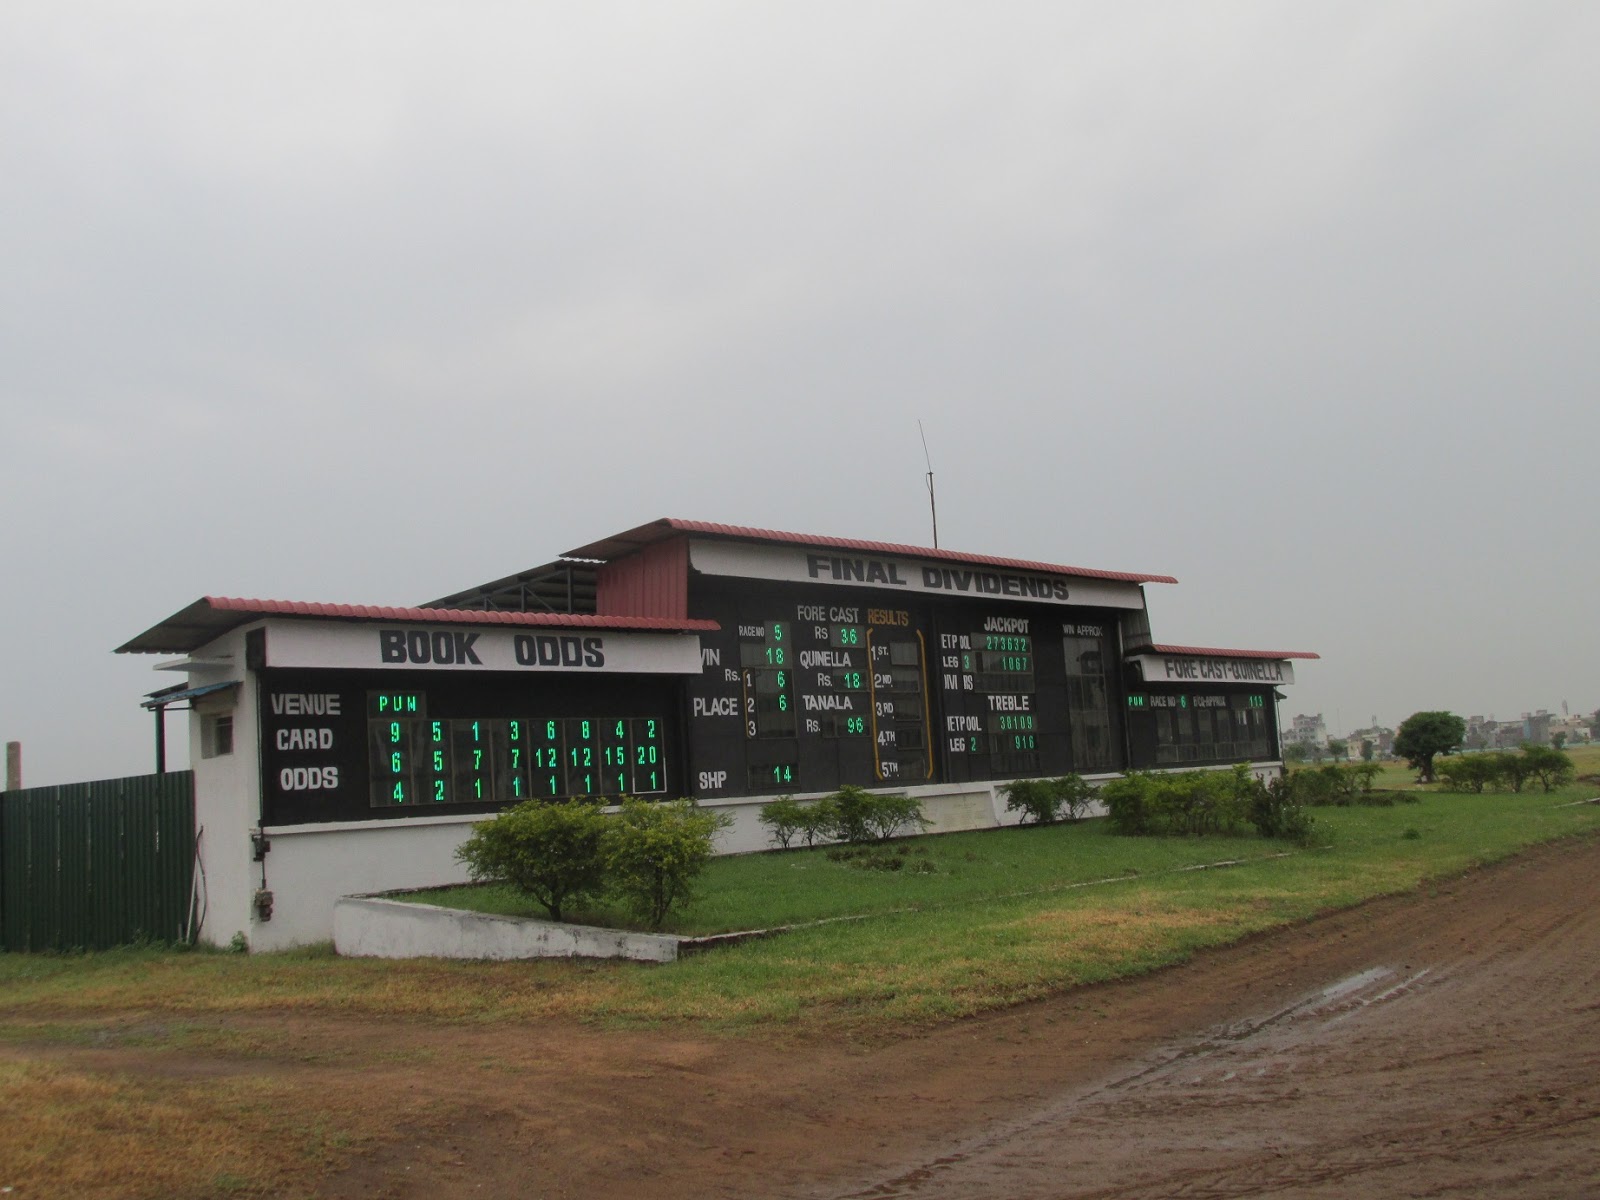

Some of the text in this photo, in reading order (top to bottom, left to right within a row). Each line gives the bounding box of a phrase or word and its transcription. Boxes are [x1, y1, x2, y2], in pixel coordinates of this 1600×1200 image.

[807, 554, 1070, 601] FINAL DIVIDENDS
[797, 605, 860, 624] FORE CAST
[867, 608, 909, 626] RESULTS
[774, 624, 783, 641] 5
[983, 616, 1030, 634] JACKPOT
[840, 628, 858, 645] 36
[379, 629, 605, 668] BOOK ODDS
[765, 647, 784, 665] 18
[799, 650, 853, 670] QUINELLA
[942, 655, 959, 668] LEG
[964, 654, 970, 670] 3
[1164, 658, 1198, 679] FORE
[746, 673, 752, 687] 1
[777, 671, 786, 688] 6
[844, 672, 860, 689] 18
[271, 693, 341, 716] VENUE
[379, 695, 417, 712] PUN
[693, 697, 739, 717] PLACE
[747, 697, 755, 713] 2
[779, 694, 787, 711] 6
[802, 694, 854, 711] TANALA
[987, 695, 1030, 711] TREBLE
[391, 719, 655, 743] 9 5 1 3 6 8 4 2
[748, 720, 757, 736] 3
[847, 717, 864, 734] 96
[276, 728, 334, 751] CARD
[949, 737, 966, 752] LEG
[391, 746, 656, 773] 6 5 7 7 12 12 15 20
[280, 766, 339, 791] ODDS
[698, 770, 727, 790] SHP
[773, 765, 792, 783] 14
[393, 771, 656, 802] 4 2 1 1 1 1 1 1
